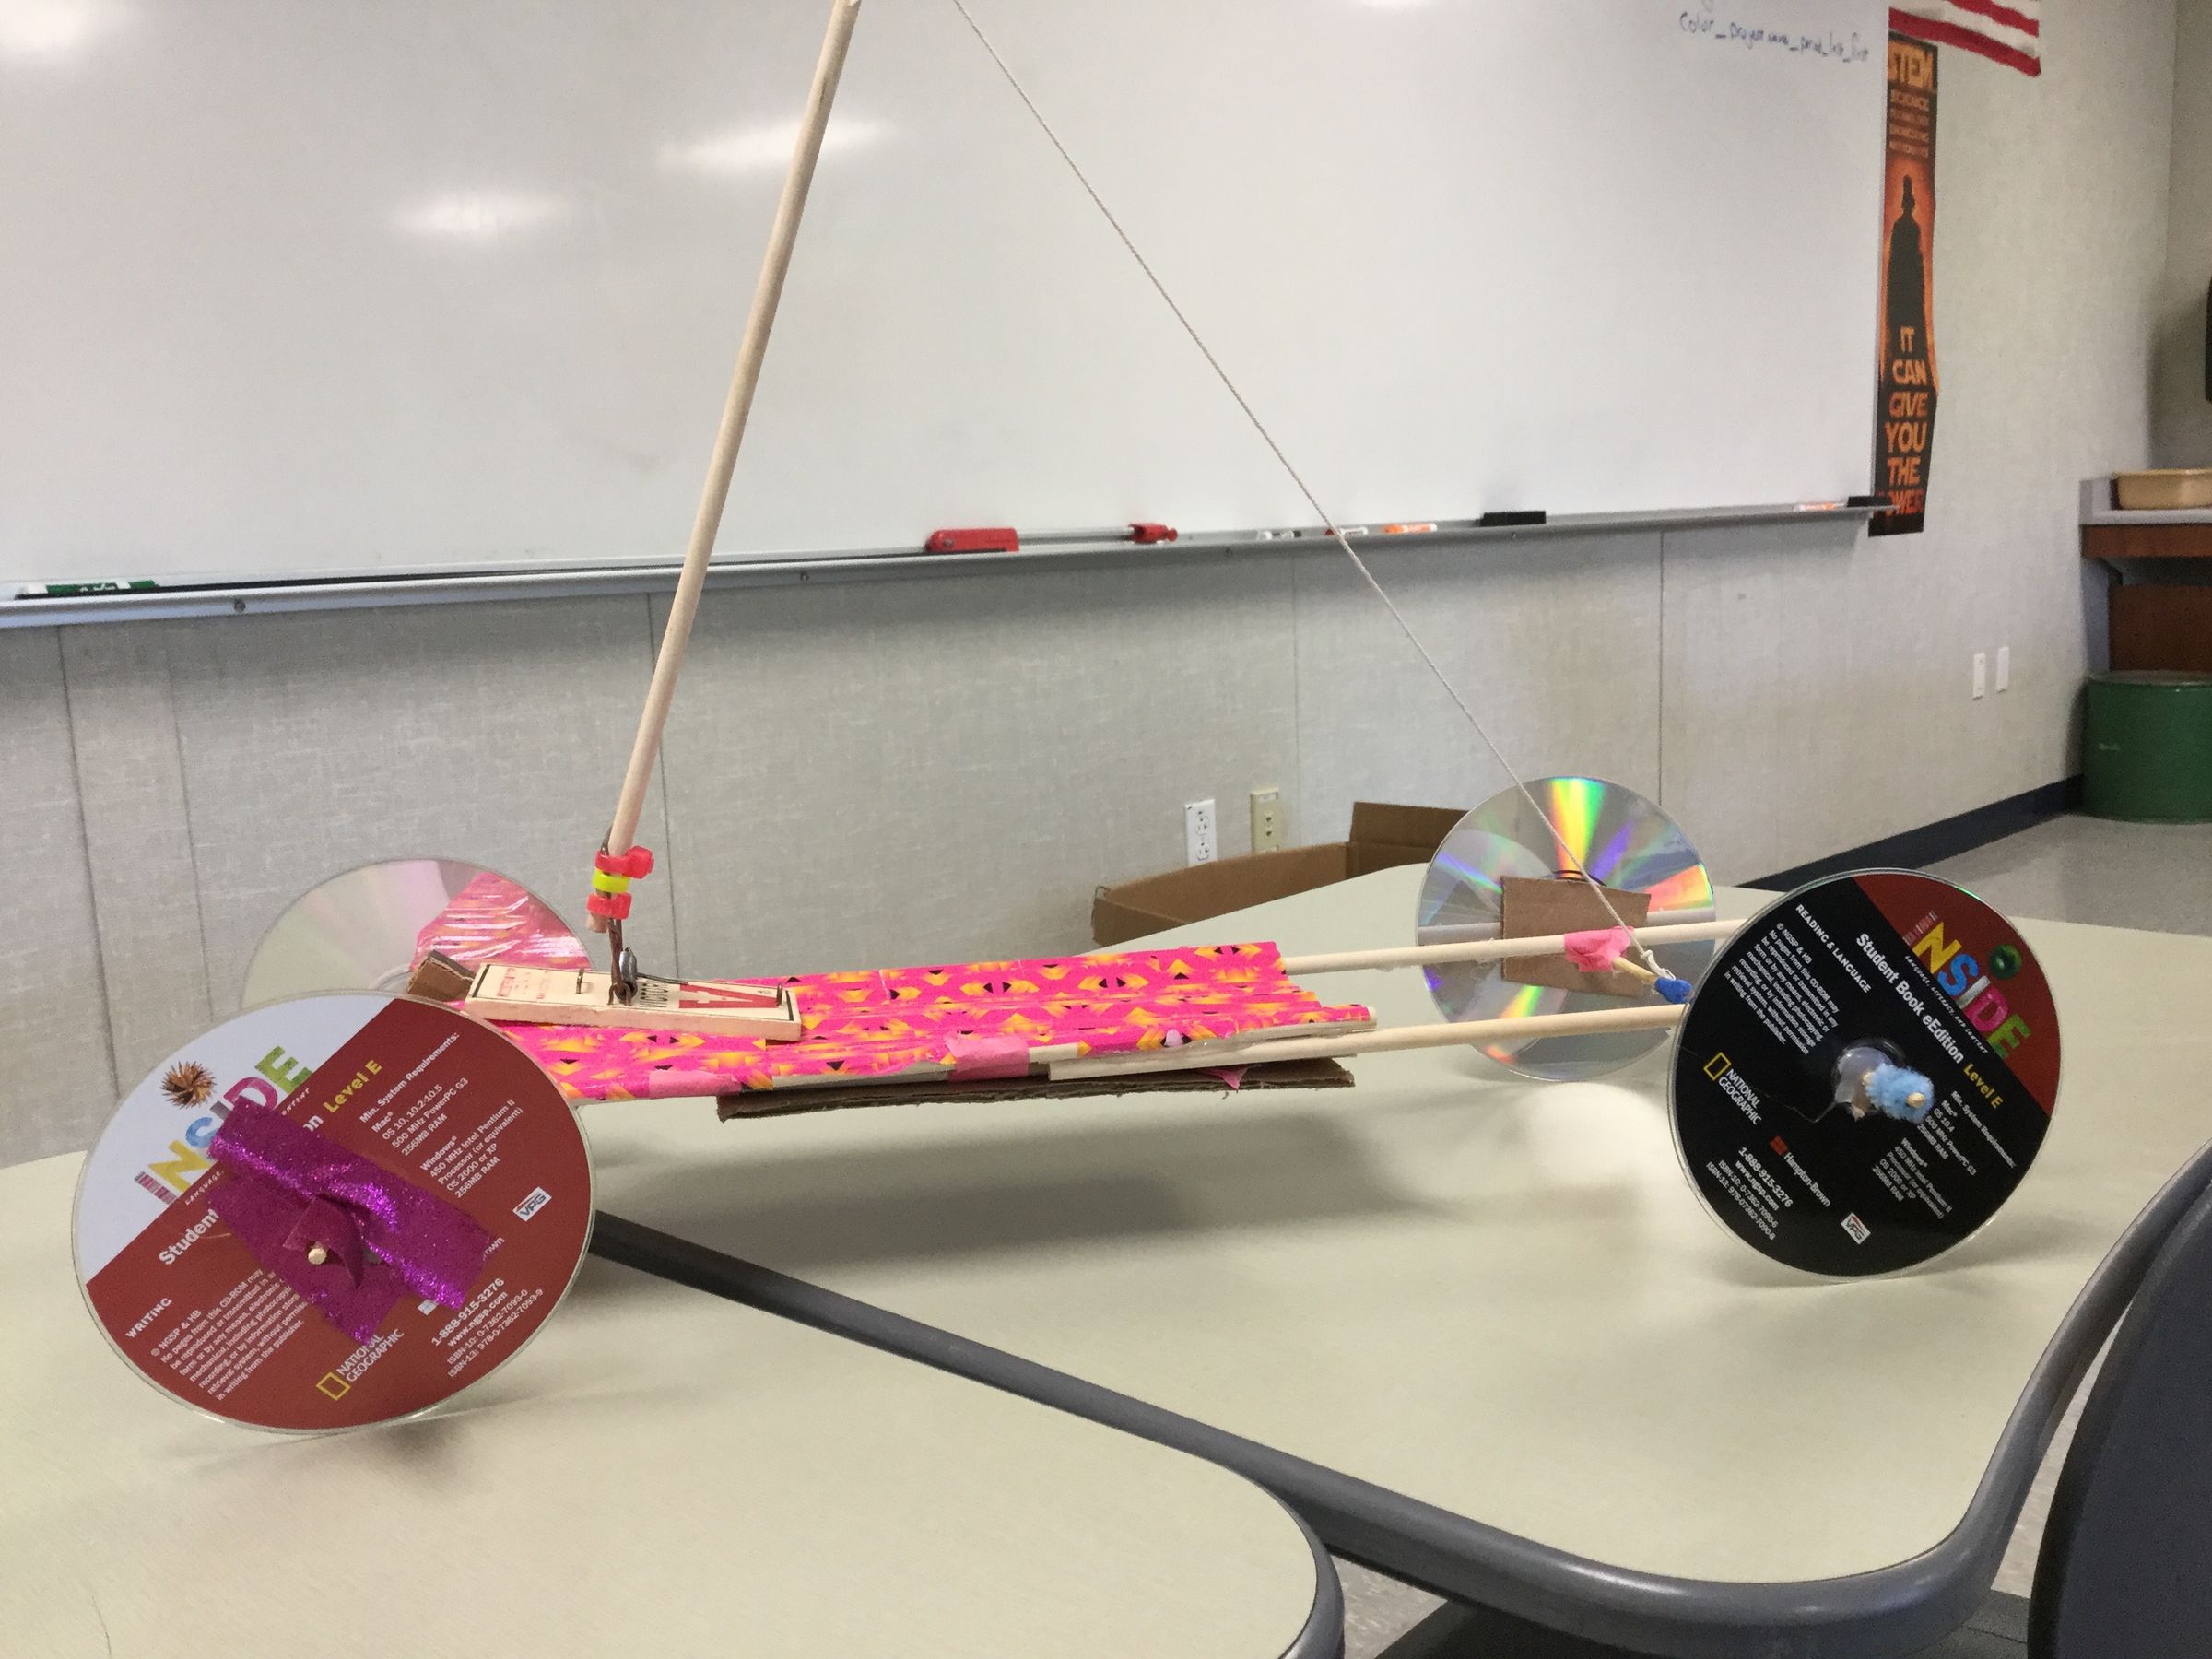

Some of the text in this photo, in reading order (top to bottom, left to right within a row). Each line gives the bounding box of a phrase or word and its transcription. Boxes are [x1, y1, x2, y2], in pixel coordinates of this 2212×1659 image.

[1892, 359, 1927, 385] CAN
[1900, 325, 1915, 353] IT
[1884, 421, 1927, 453] YOU
[1889, 391, 1928, 418] GIVE
[1888, 456, 1921, 487] THE
[1768, 928, 1839, 1014] No pages from this CD-ROM may
[1781, 928, 1813, 964] NGSP HB
[1794, 903, 1872, 993] READING & LANGUAGE
[1724, 970, 1789, 1045] in writing from the publisher.
[1731, 963, 1810, 1055] retrieval system, without permission
[1736, 956, 1818, 1048] recording, or by information storage
[1753, 942, 1830, 1032] form or by any means, electronic or
[1760, 935, 1838, 1028] be reproduced or transmitted in any
[1899, 909, 2035, 1060] INSIDE
[1853, 932, 2005, 1109] Student Book eEdition Level E
[359, 1031, 462, 1123] Min. System Requirements:
[381, 1127, 395, 1139] OS
[405, 1083, 443, 1117] 10.2-10.5
[1716, 1076, 1762, 1125] GEOGRAPHIC
[1725, 1069, 1762, 1108] NATIONAL
[390, 1077, 469, 1148] 500 MHz PowerPC G3
[399, 1112, 448, 1156] 256MB RAM
[428, 1104, 509, 1177] 450 MHz Intel Pentium
[436, 1105, 524, 1184] Processor (or equivalent)
[156, 1059, 382, 1265] Student Level E
[444, 1142, 500, 1191] OS 2000 or XP
[453, 1155, 500, 1197] 256MB RAM
[1732, 1159, 1781, 1212] www.ngsp.com
[1737, 1146, 1794, 1208] 1-888-915-3276
[1781, 1151, 1833, 1208] Hampton-Brown
[519, 1193, 547, 1218] VPG
[124, 1296, 172, 1339] WRITING
[157, 1309, 202, 1349] NGSP HB
[159, 1351, 173, 1363] No
[171, 1334, 194, 1354] pages
[189, 1317, 209, 1335] from
[206, 1305, 222, 1320] this
[218, 1280, 249, 1308] CD-ROM
[245, 1268, 265, 1285] may
[168, 1358, 182, 1369] be
[177, 1324, 218, 1361] reproduced
[214, 1318, 224, 1327] or
[220, 1283, 261, 1320] transmitted
[257, 1277, 268, 1286] in
[177, 1358, 197, 1375] form
[194, 1351, 206, 1360] or
[201, 1342, 216, 1354] by
[211, 1332, 229, 1346] any
[223, 1310, 252, 1335] means,
[245, 1280, 280, 1312] electronic
[195, 1291, 300, 1389] recording, or by information stora
[429, 1276, 506, 1346] 1-888-915-3276
[445, 1289, 511, 1348] www.ngsp.com
[445, 1288, 529, 1364] ISBN-10: 0-7362-7093-0
[186, 1344, 229, 1382] mechanical,
[224, 1317, 258, 1347] including
[205, 1367, 235, 1394] retrieval
[230, 1345, 261, 1371] system,
[255, 1323, 283, 1347] without
[214, 1317, 305, 1400] in writing from the publisher.
[343, 1327, 405, 1382] GEOGRAPHIC
